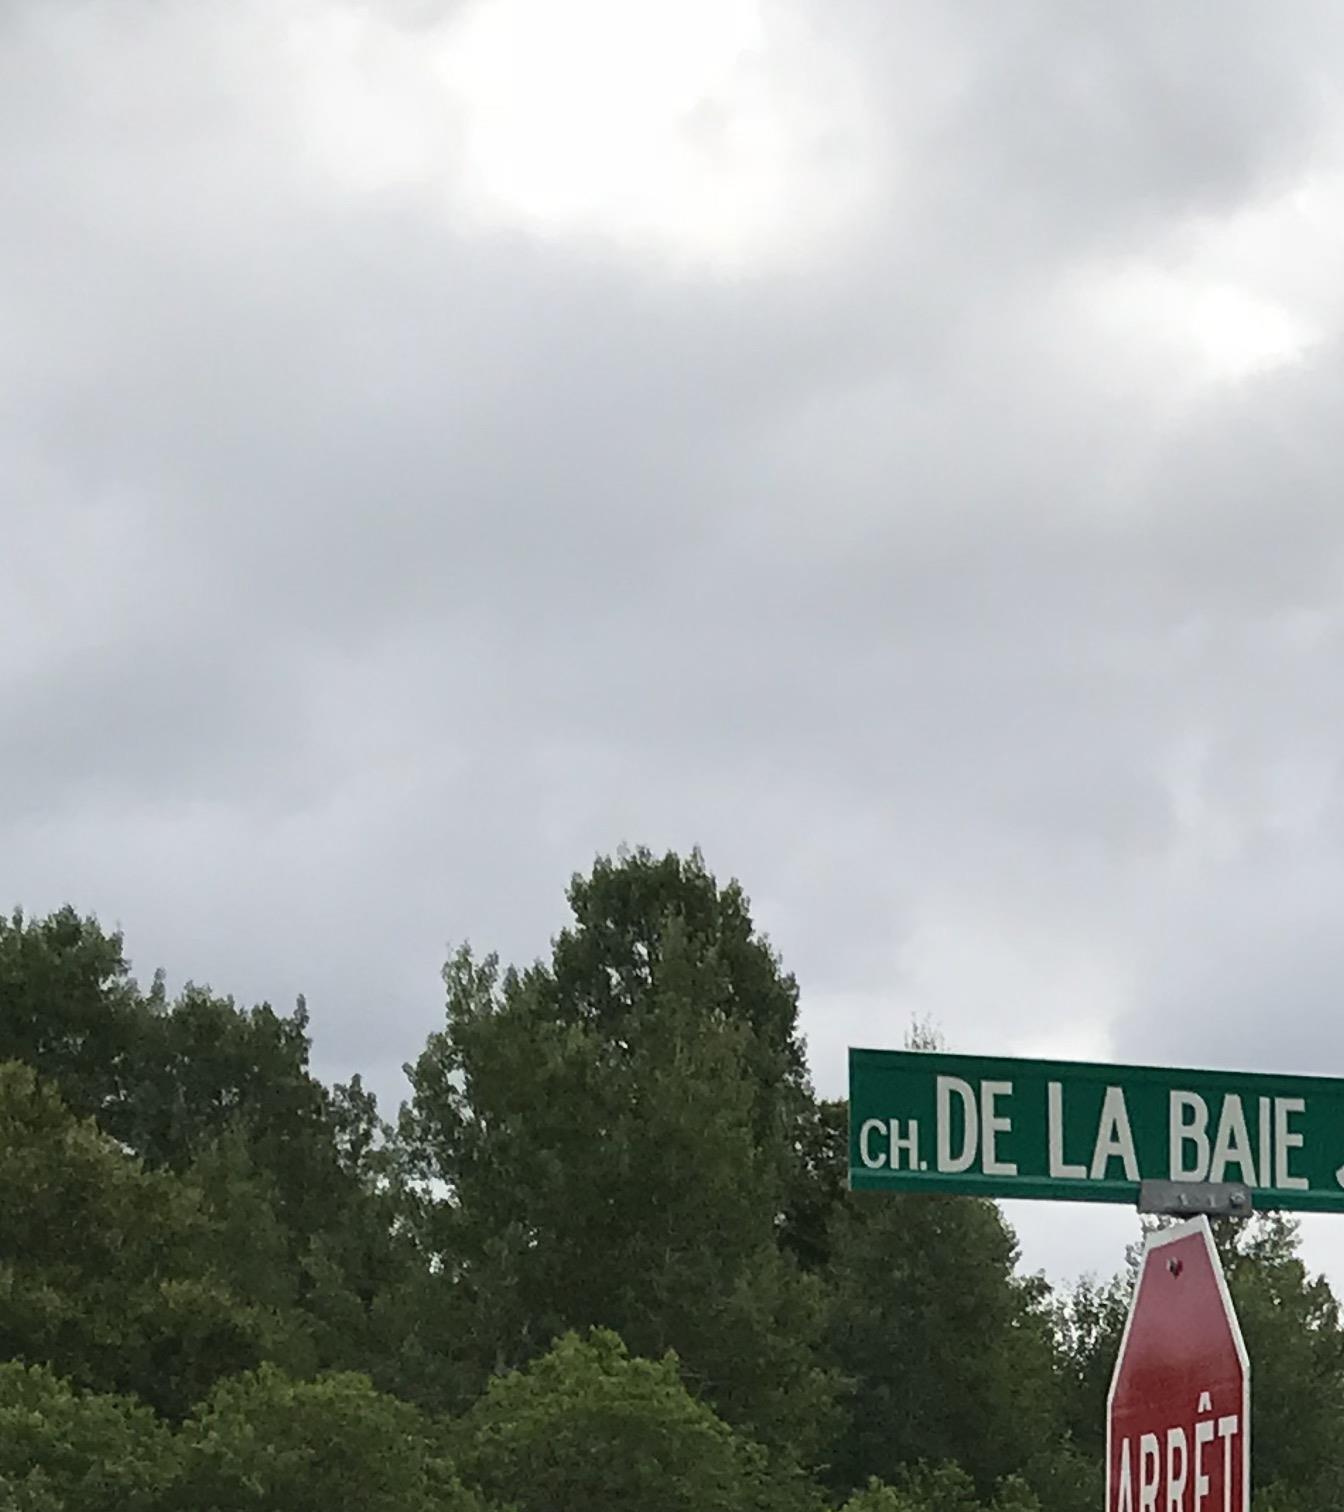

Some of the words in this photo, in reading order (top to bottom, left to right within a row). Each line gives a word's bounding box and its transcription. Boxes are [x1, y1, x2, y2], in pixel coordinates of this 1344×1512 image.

[859, 1117, 928, 1172] CH.
[936, 1075, 1018, 1176] DE
[1047, 1081, 1142, 1182] LA
[1169, 1089, 1310, 1191] BAIE
